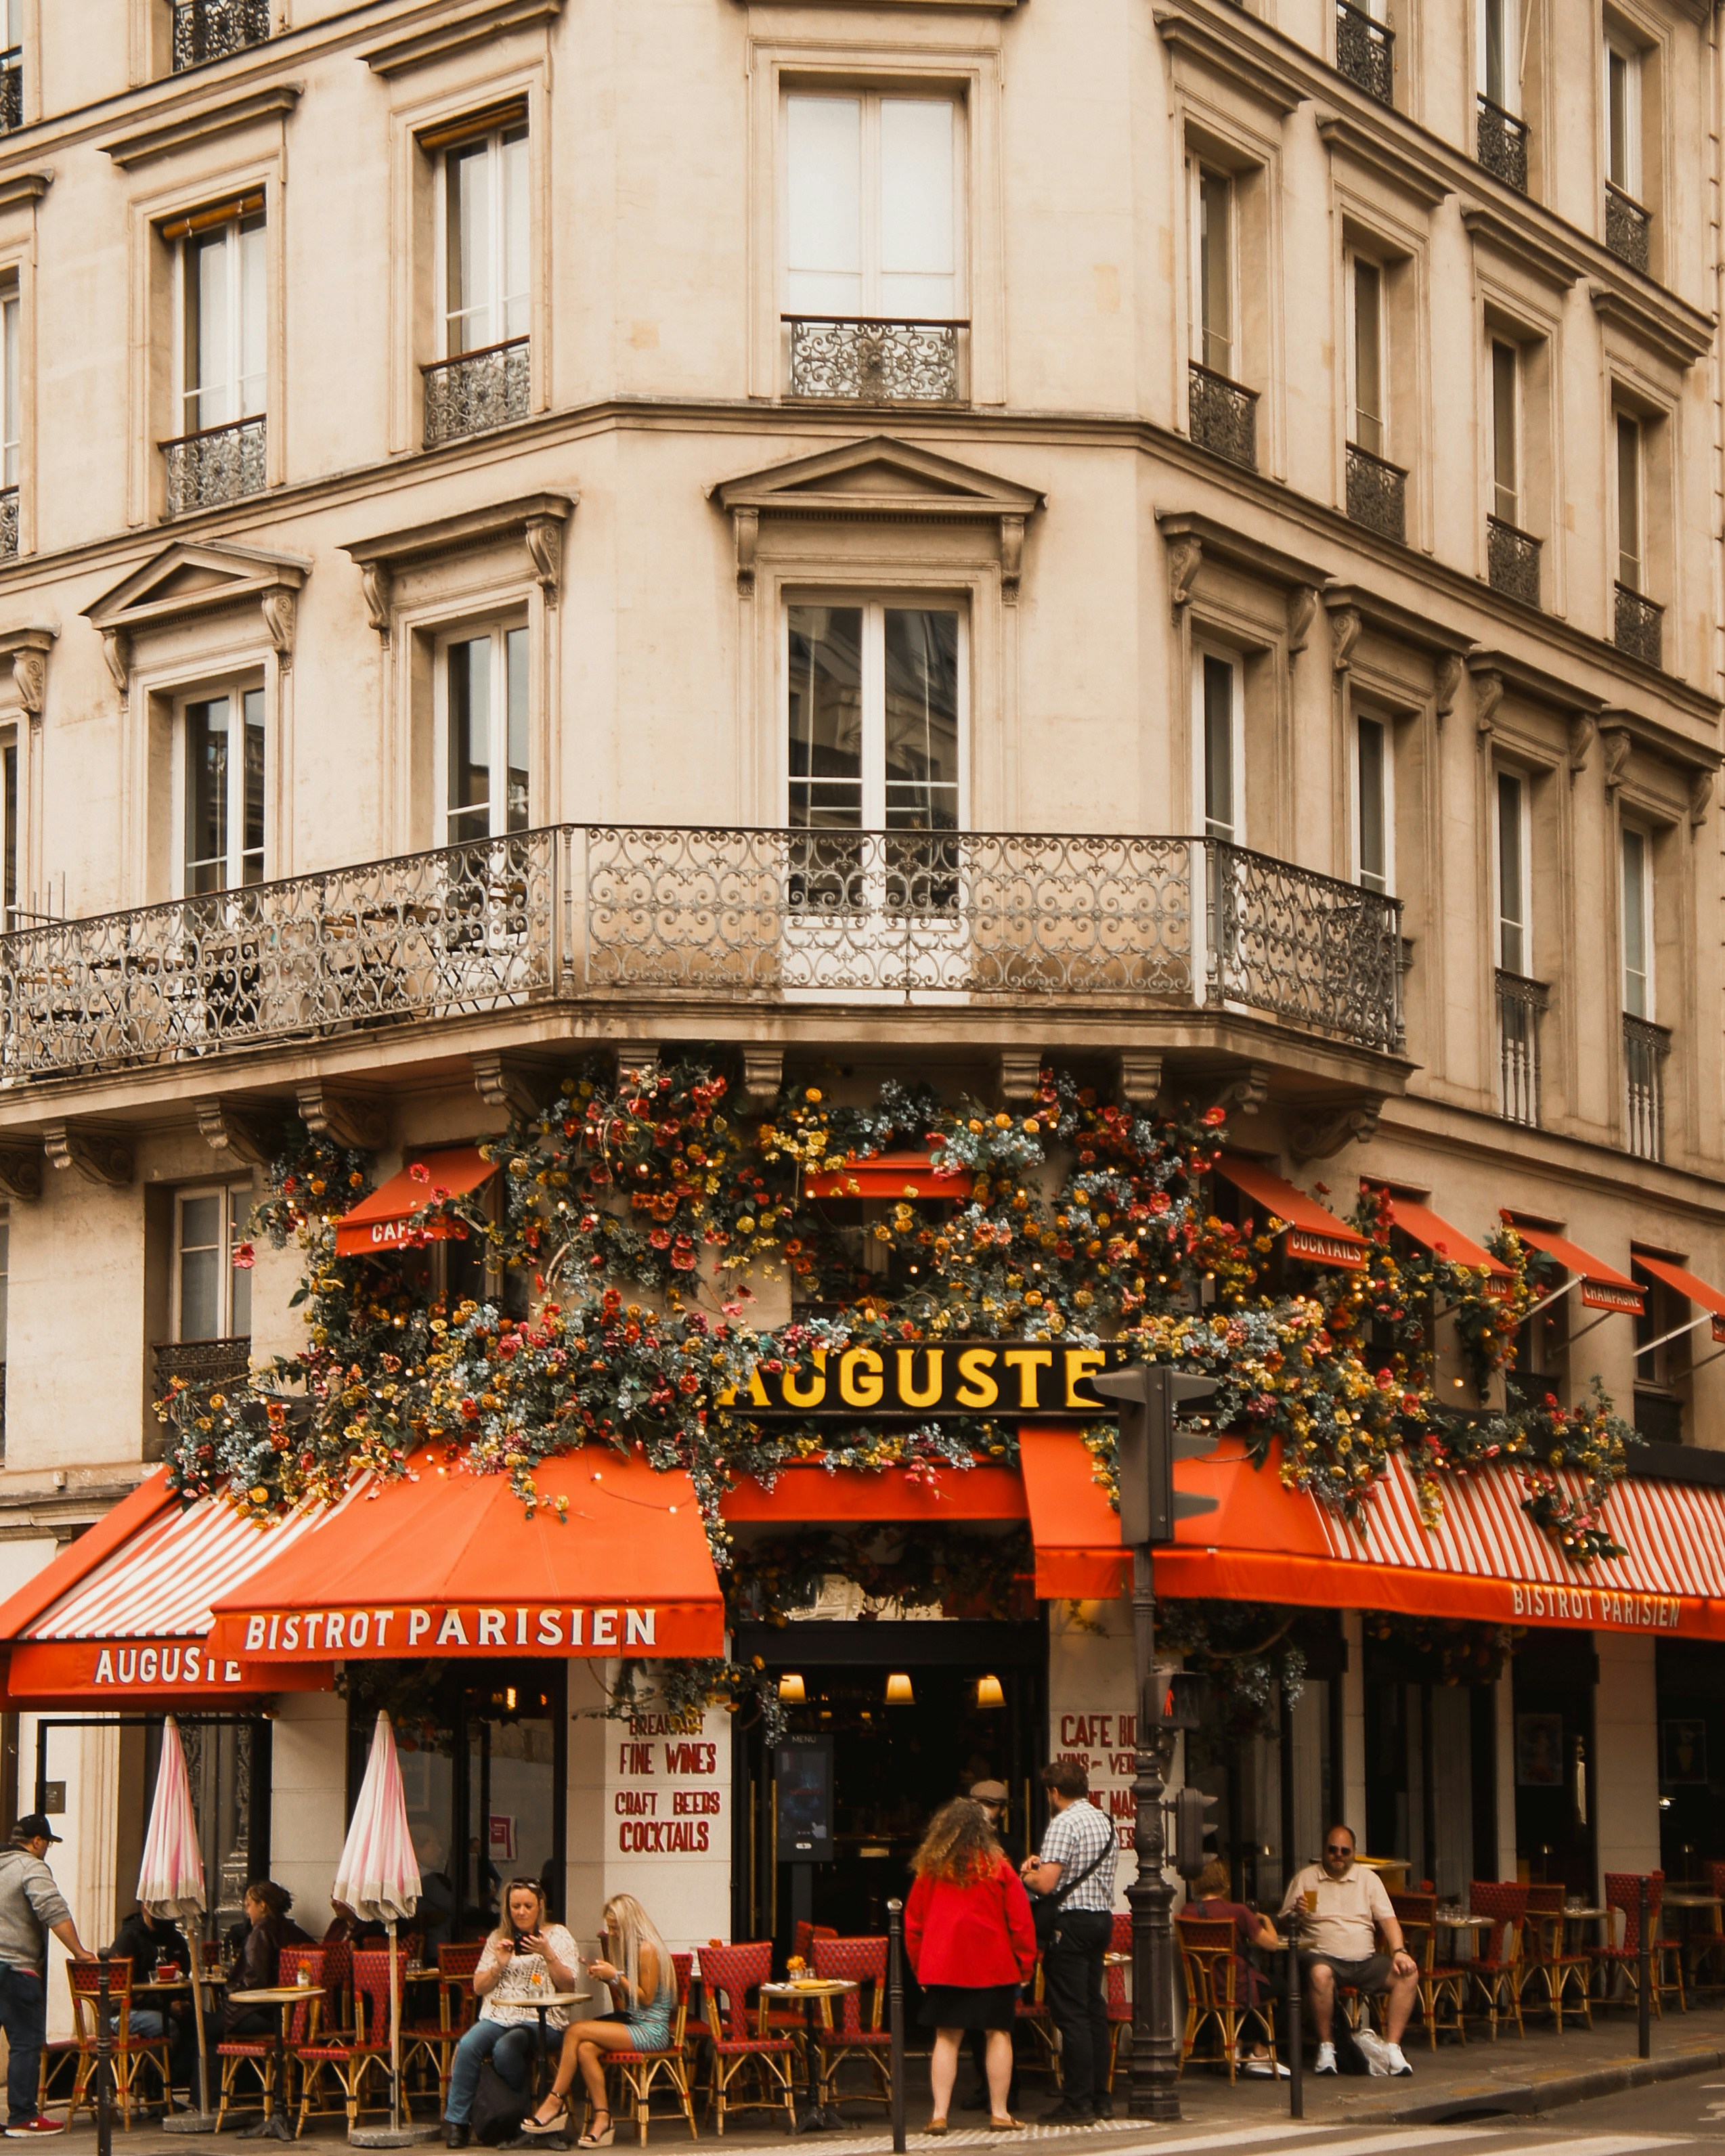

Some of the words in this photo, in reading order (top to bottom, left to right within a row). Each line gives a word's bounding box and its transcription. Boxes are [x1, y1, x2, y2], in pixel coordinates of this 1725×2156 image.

[1292, 1232, 1361, 1262] COCKTAILS
[1491, 1279, 1507, 1294] INS
[1584, 1281, 1640, 1308] CHAMPAGNE
[718, 1349, 1106, 1408] AUGUSTE
[1511, 1584, 1593, 1620] BISTROT
[1599, 1591, 1680, 1627] PARISIEN
[245, 1610, 393, 1650] BISTROT
[409, 1608, 656, 1646] PARISIEN
[791, 1735, 816, 1744] MENU
[1061, 1715, 1113, 1747] CAFE
[619, 1743, 655, 1774] FINE
[665, 1742, 716, 1774] WINES
[615, 1792, 658, 1816] CRAFT
[673, 1791, 720, 1816] BEERS
[619, 1822, 709, 1852] COCKTAILS
